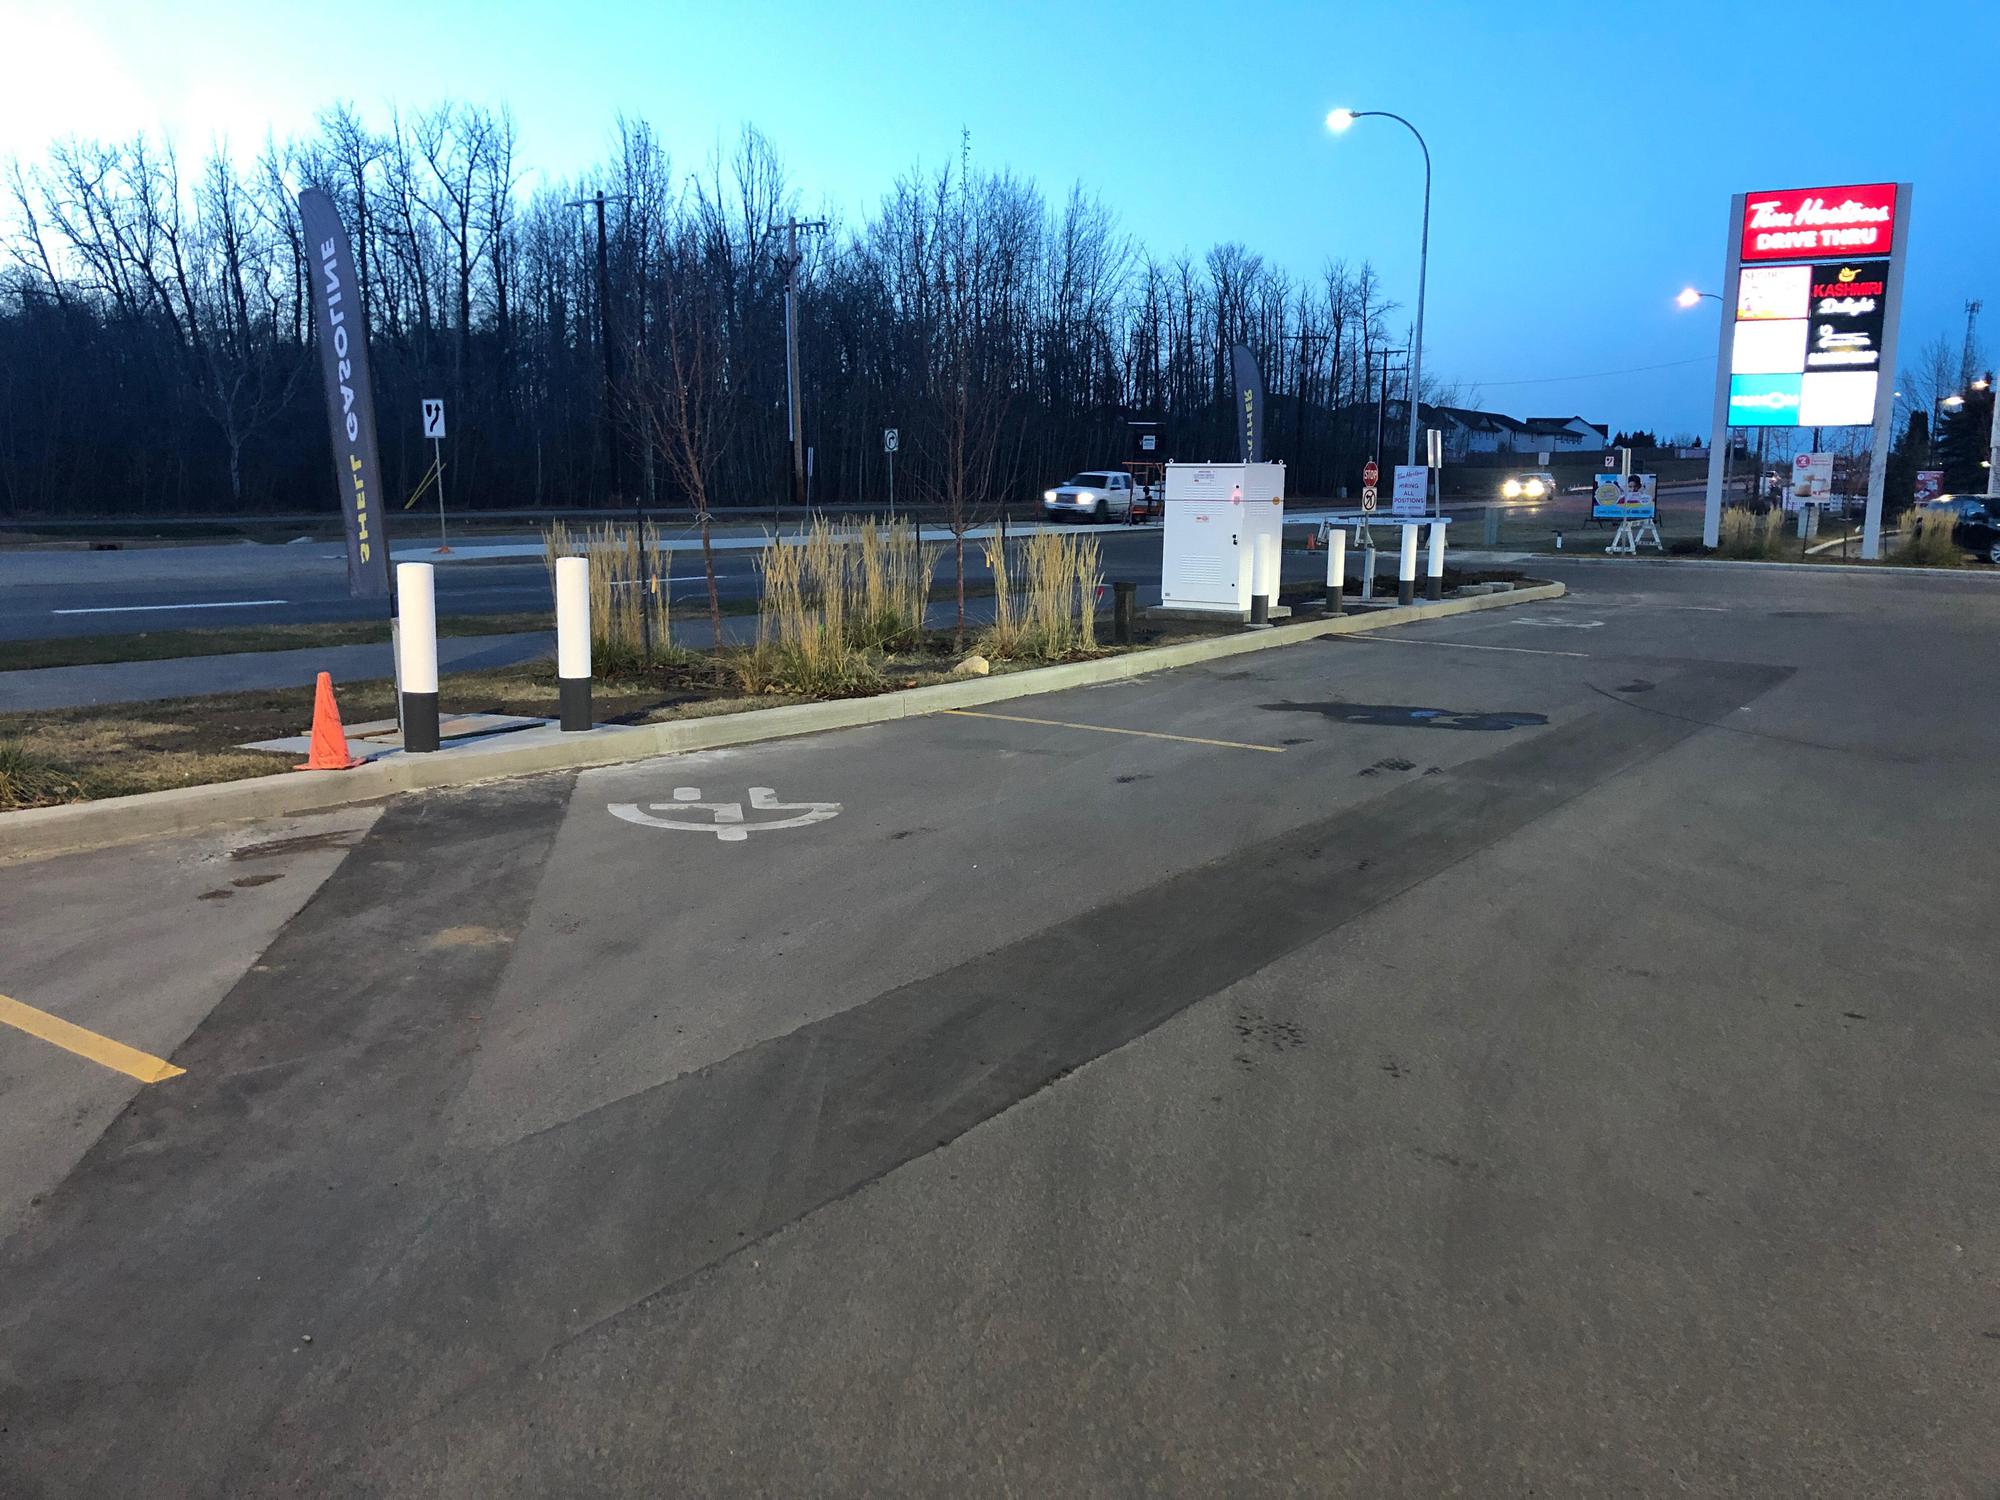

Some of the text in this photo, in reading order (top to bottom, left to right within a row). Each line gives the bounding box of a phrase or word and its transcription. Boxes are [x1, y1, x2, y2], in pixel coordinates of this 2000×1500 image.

[1750, 197, 1889, 229] Tim Hortons
[1756, 226, 1877, 250] DRIVE THRU
[1813, 281, 1883, 298] KASHMIRI
[1364, 469, 1378, 480] STOP
